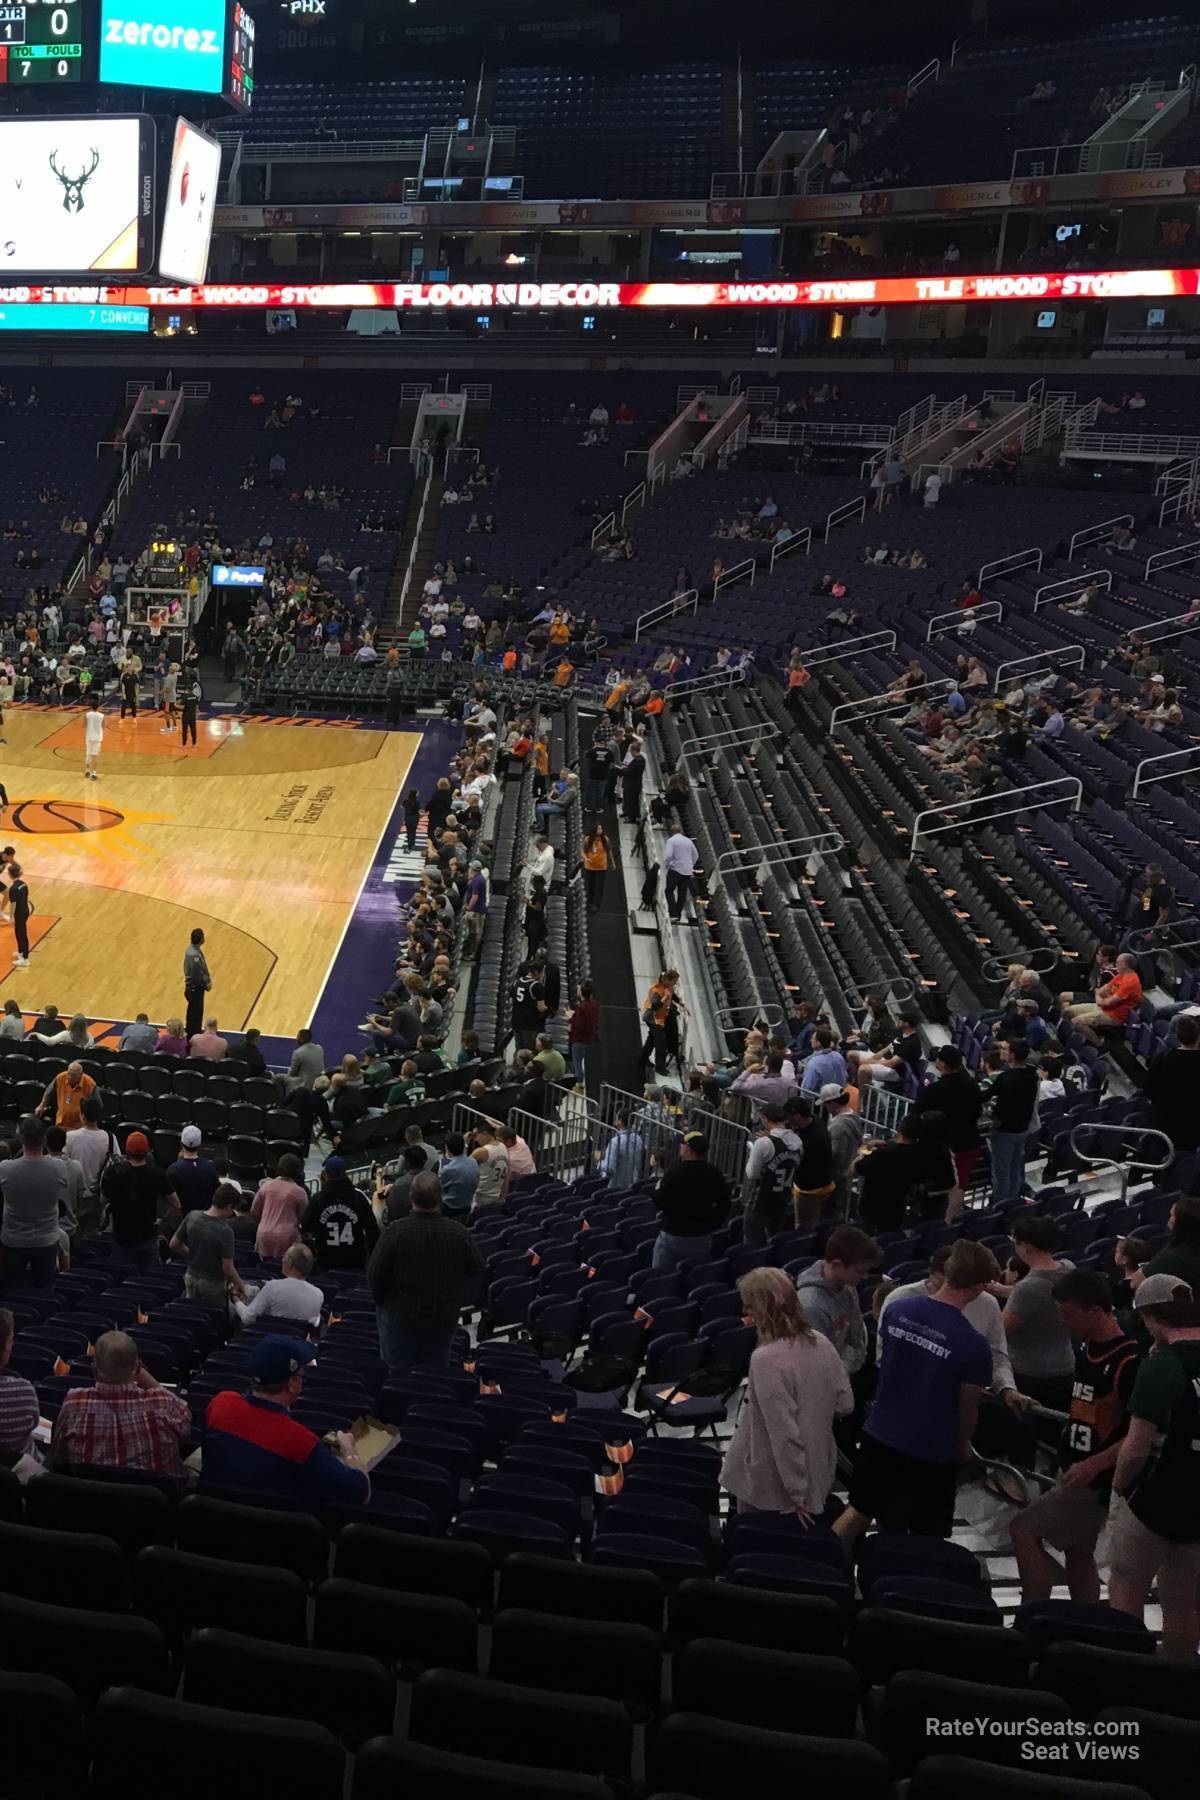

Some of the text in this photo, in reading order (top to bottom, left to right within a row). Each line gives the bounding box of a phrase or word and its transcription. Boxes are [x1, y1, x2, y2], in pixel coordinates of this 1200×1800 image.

[4, 24, 12, 39] 1
[51, 9, 68, 35] 0
[106, 18, 220, 54] zerorez
[14, 45, 80, 57] TOL FOULS
[21, 60, 68, 77] 7 0
[142, 175, 152, 216] verizon
[203, 287, 268, 303] WOOD
[395, 284, 620, 305] FLOOR DECOR
[729, 285, 797, 301] WOOD
[917, 280, 963, 298] TILE
[976, 277, 1048, 297] WOOD
[516, 987, 526, 1002] 5
[326, 1221, 355, 1246] 34
[1070, 1423, 1093, 1452] 13
